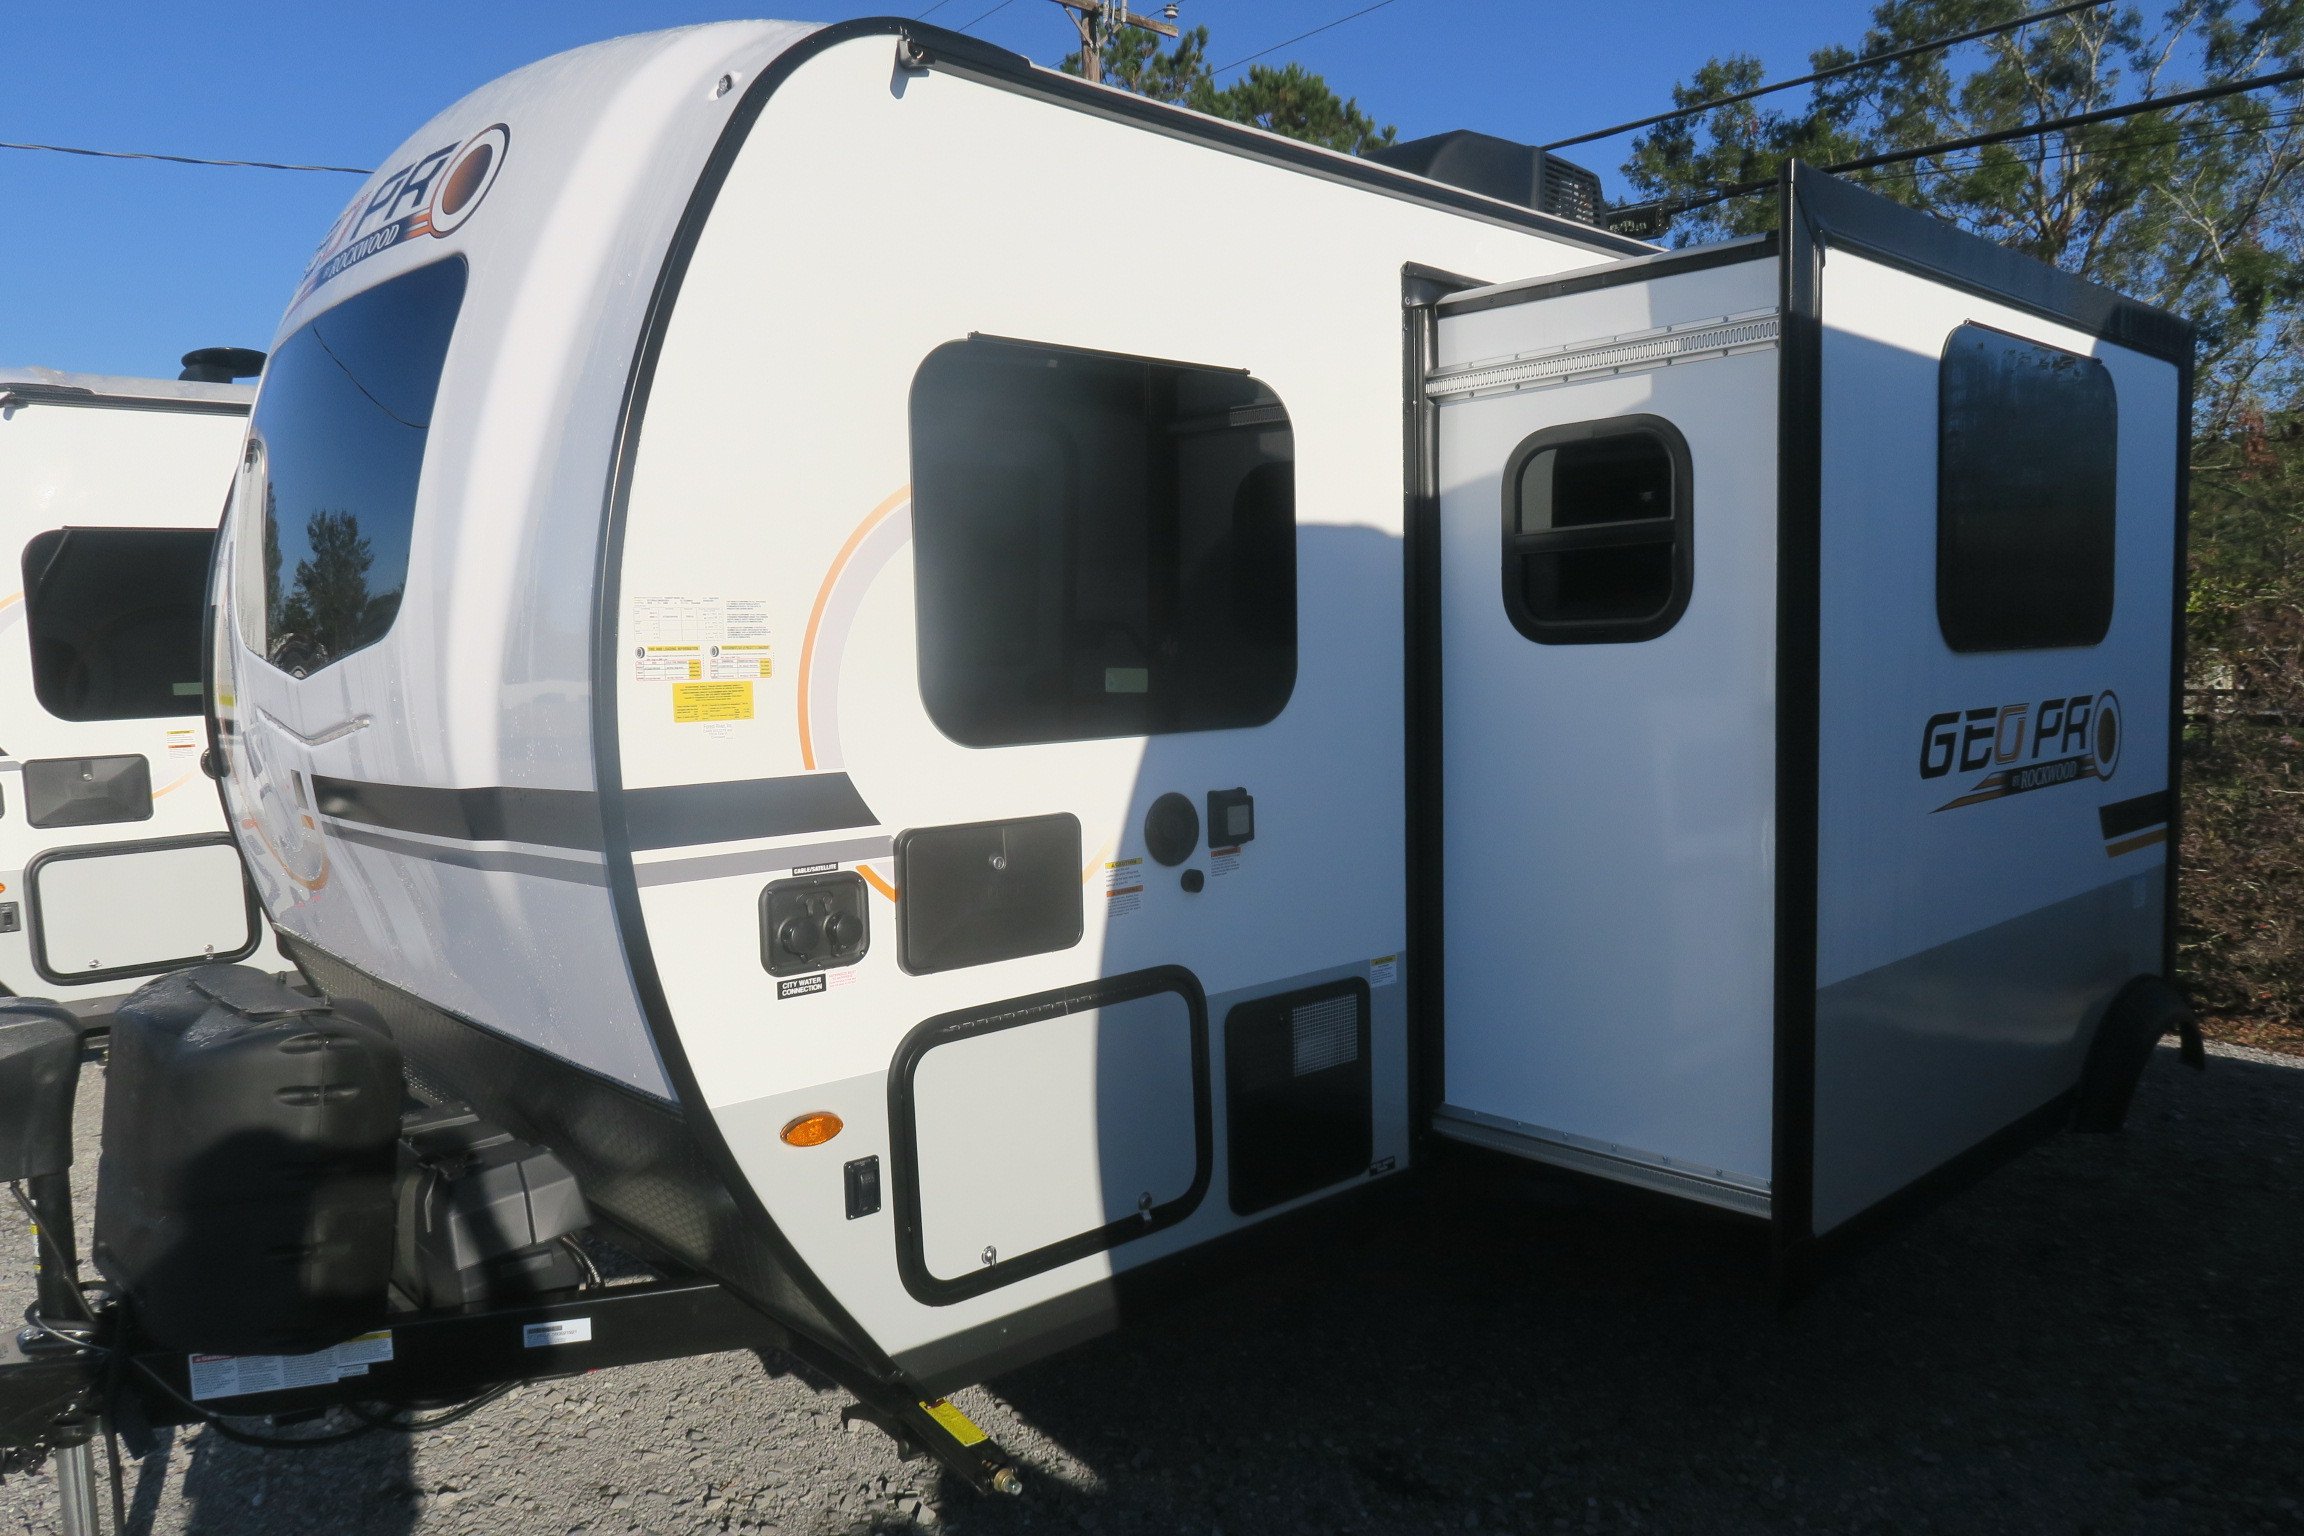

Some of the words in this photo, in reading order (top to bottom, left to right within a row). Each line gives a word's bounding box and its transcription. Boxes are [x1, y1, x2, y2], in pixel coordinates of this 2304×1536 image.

[328, 223, 400, 278] ROCKWOOD
[1919, 702, 2030, 780] GEO
[2020, 760, 2078, 789] ROCKWOOD
[793, 863, 837, 876] CABLE/SATELLITE
[781, 983, 823, 997] CONNECTION
[782, 979, 798, 990] CITY
[798, 976, 822, 988] WATER
